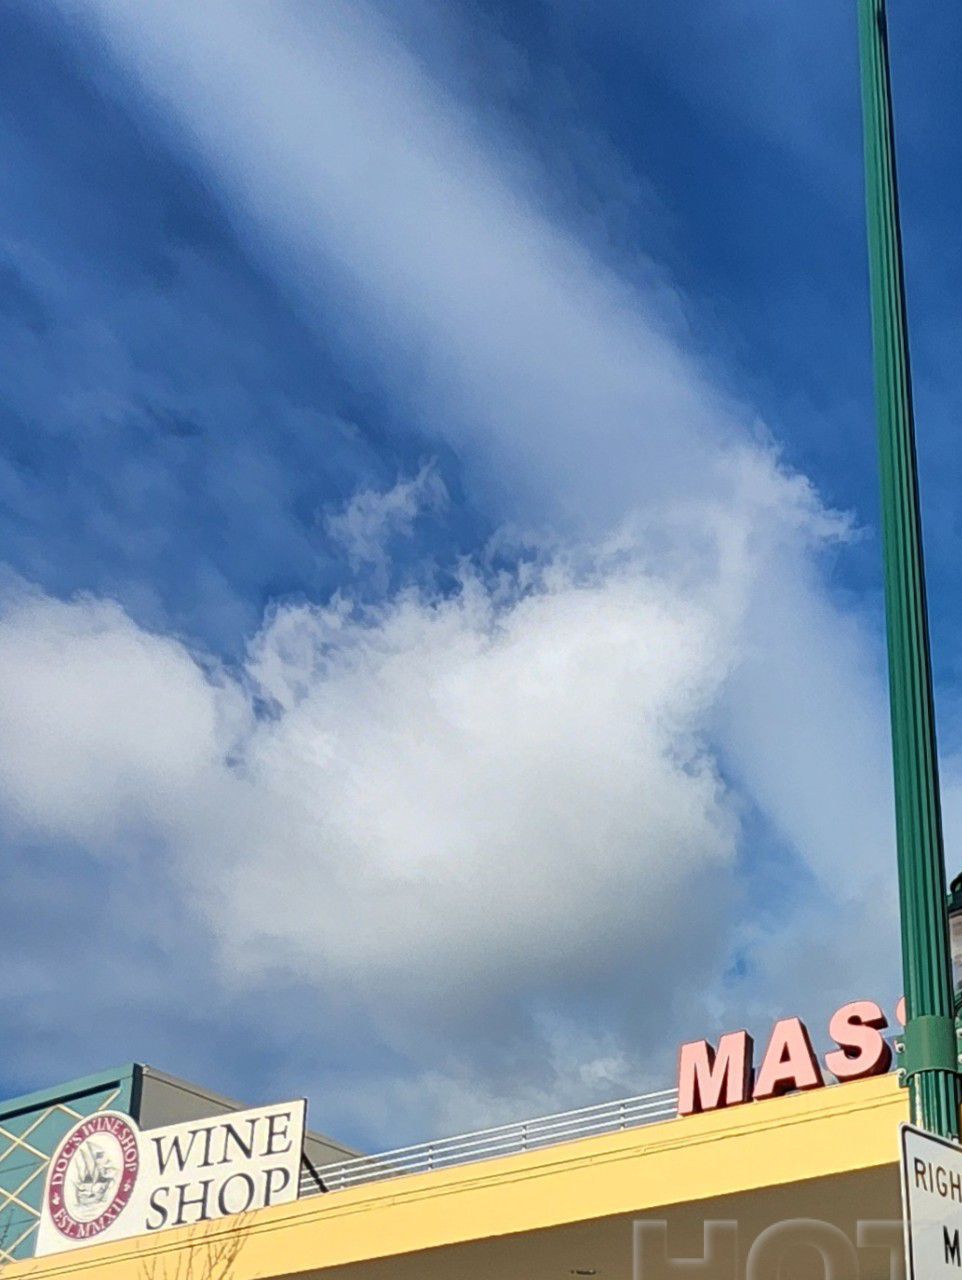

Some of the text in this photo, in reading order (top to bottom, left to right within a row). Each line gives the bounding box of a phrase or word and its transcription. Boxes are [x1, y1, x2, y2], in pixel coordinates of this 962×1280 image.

[82, 1116, 123, 1136] WINE
[119, 1127, 138, 1172] SHOP
[151, 1112, 292, 1175] WINE
[145, 1167, 290, 1230] SHOP
